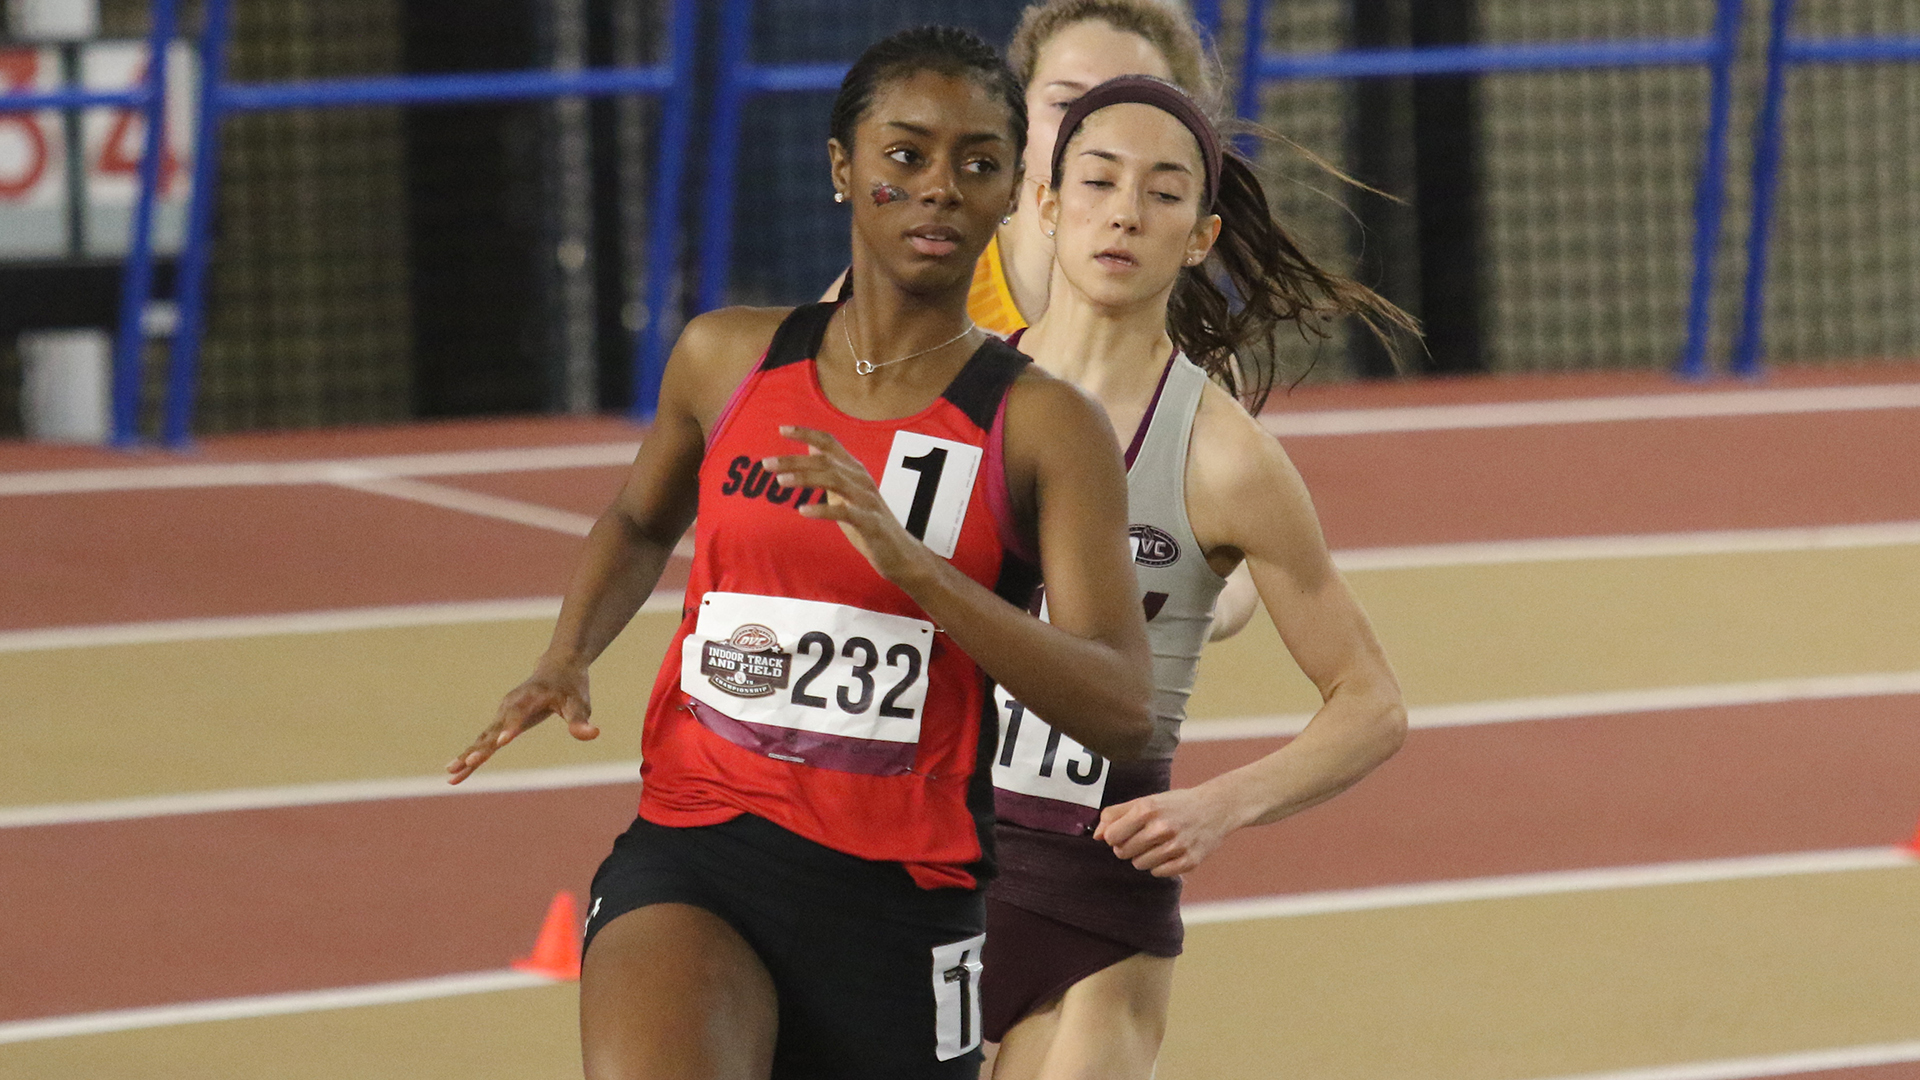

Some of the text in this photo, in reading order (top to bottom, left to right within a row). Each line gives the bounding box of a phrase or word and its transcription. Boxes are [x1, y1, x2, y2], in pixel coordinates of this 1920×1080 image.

[901, 447, 948, 542] 1
[708, 657, 782, 678] AND FIELD
[709, 646, 783, 668] INDOOR TRACK
[740, 636, 767, 646] OVC
[715, 677, 767, 694] CHAMPIONSHIP
[791, 631, 922, 719] 232
[999, 700, 1104, 786] 113
[943, 949, 971, 1049] 1
